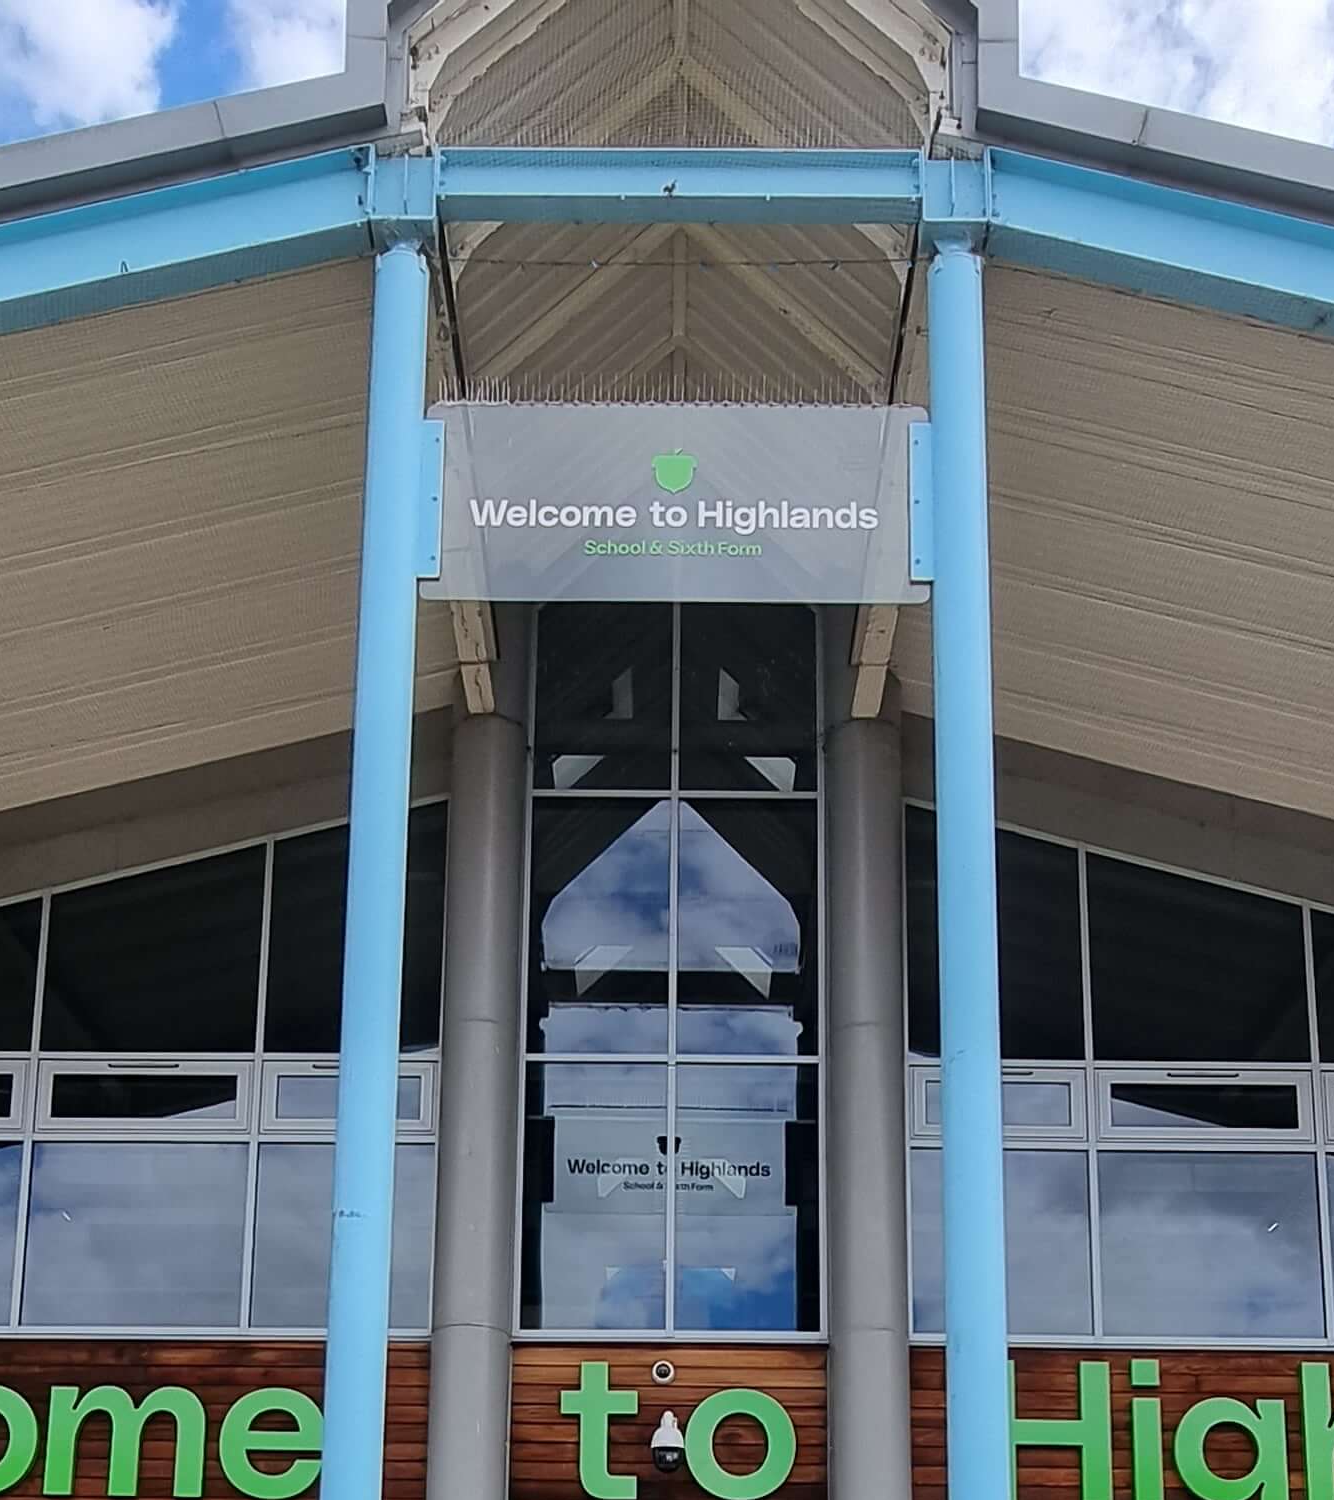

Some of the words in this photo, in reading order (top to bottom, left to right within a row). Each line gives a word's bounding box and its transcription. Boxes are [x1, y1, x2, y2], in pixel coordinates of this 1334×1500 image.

[470, 498, 638, 528] Welcome
[649, 500, 688, 528] to
[698, 500, 879, 536] Highlands
[584, 539, 646, 556] School
[650, 540, 663, 556] &
[667, 540, 715, 556] Sixth
[718, 541, 763, 556] Form
